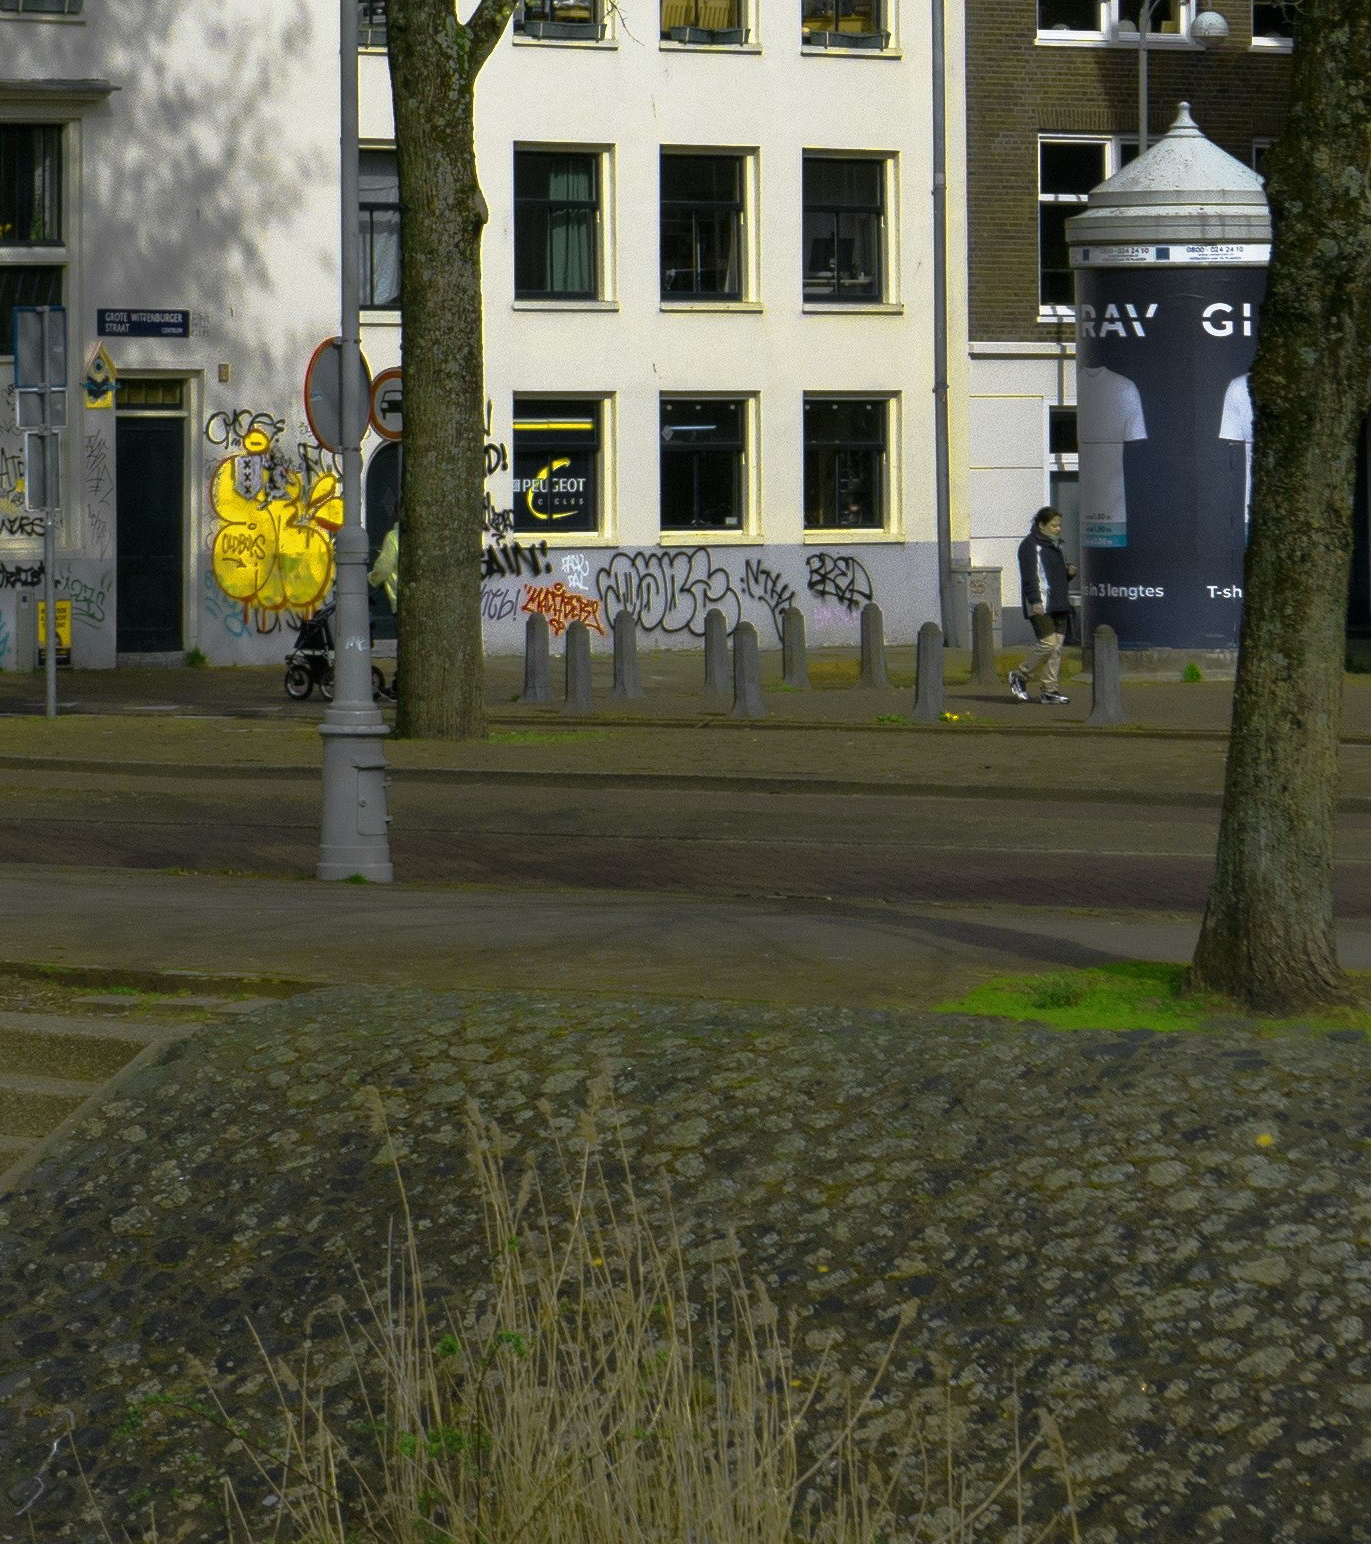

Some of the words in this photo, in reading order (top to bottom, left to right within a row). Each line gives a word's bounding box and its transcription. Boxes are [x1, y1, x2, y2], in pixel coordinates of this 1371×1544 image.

[105, 312, 128, 322] GROTE
[131, 313, 183, 323] WITTENBURGER
[105, 323, 130, 333] STRAAT
[1108, 584, 1164, 600] lengtes
